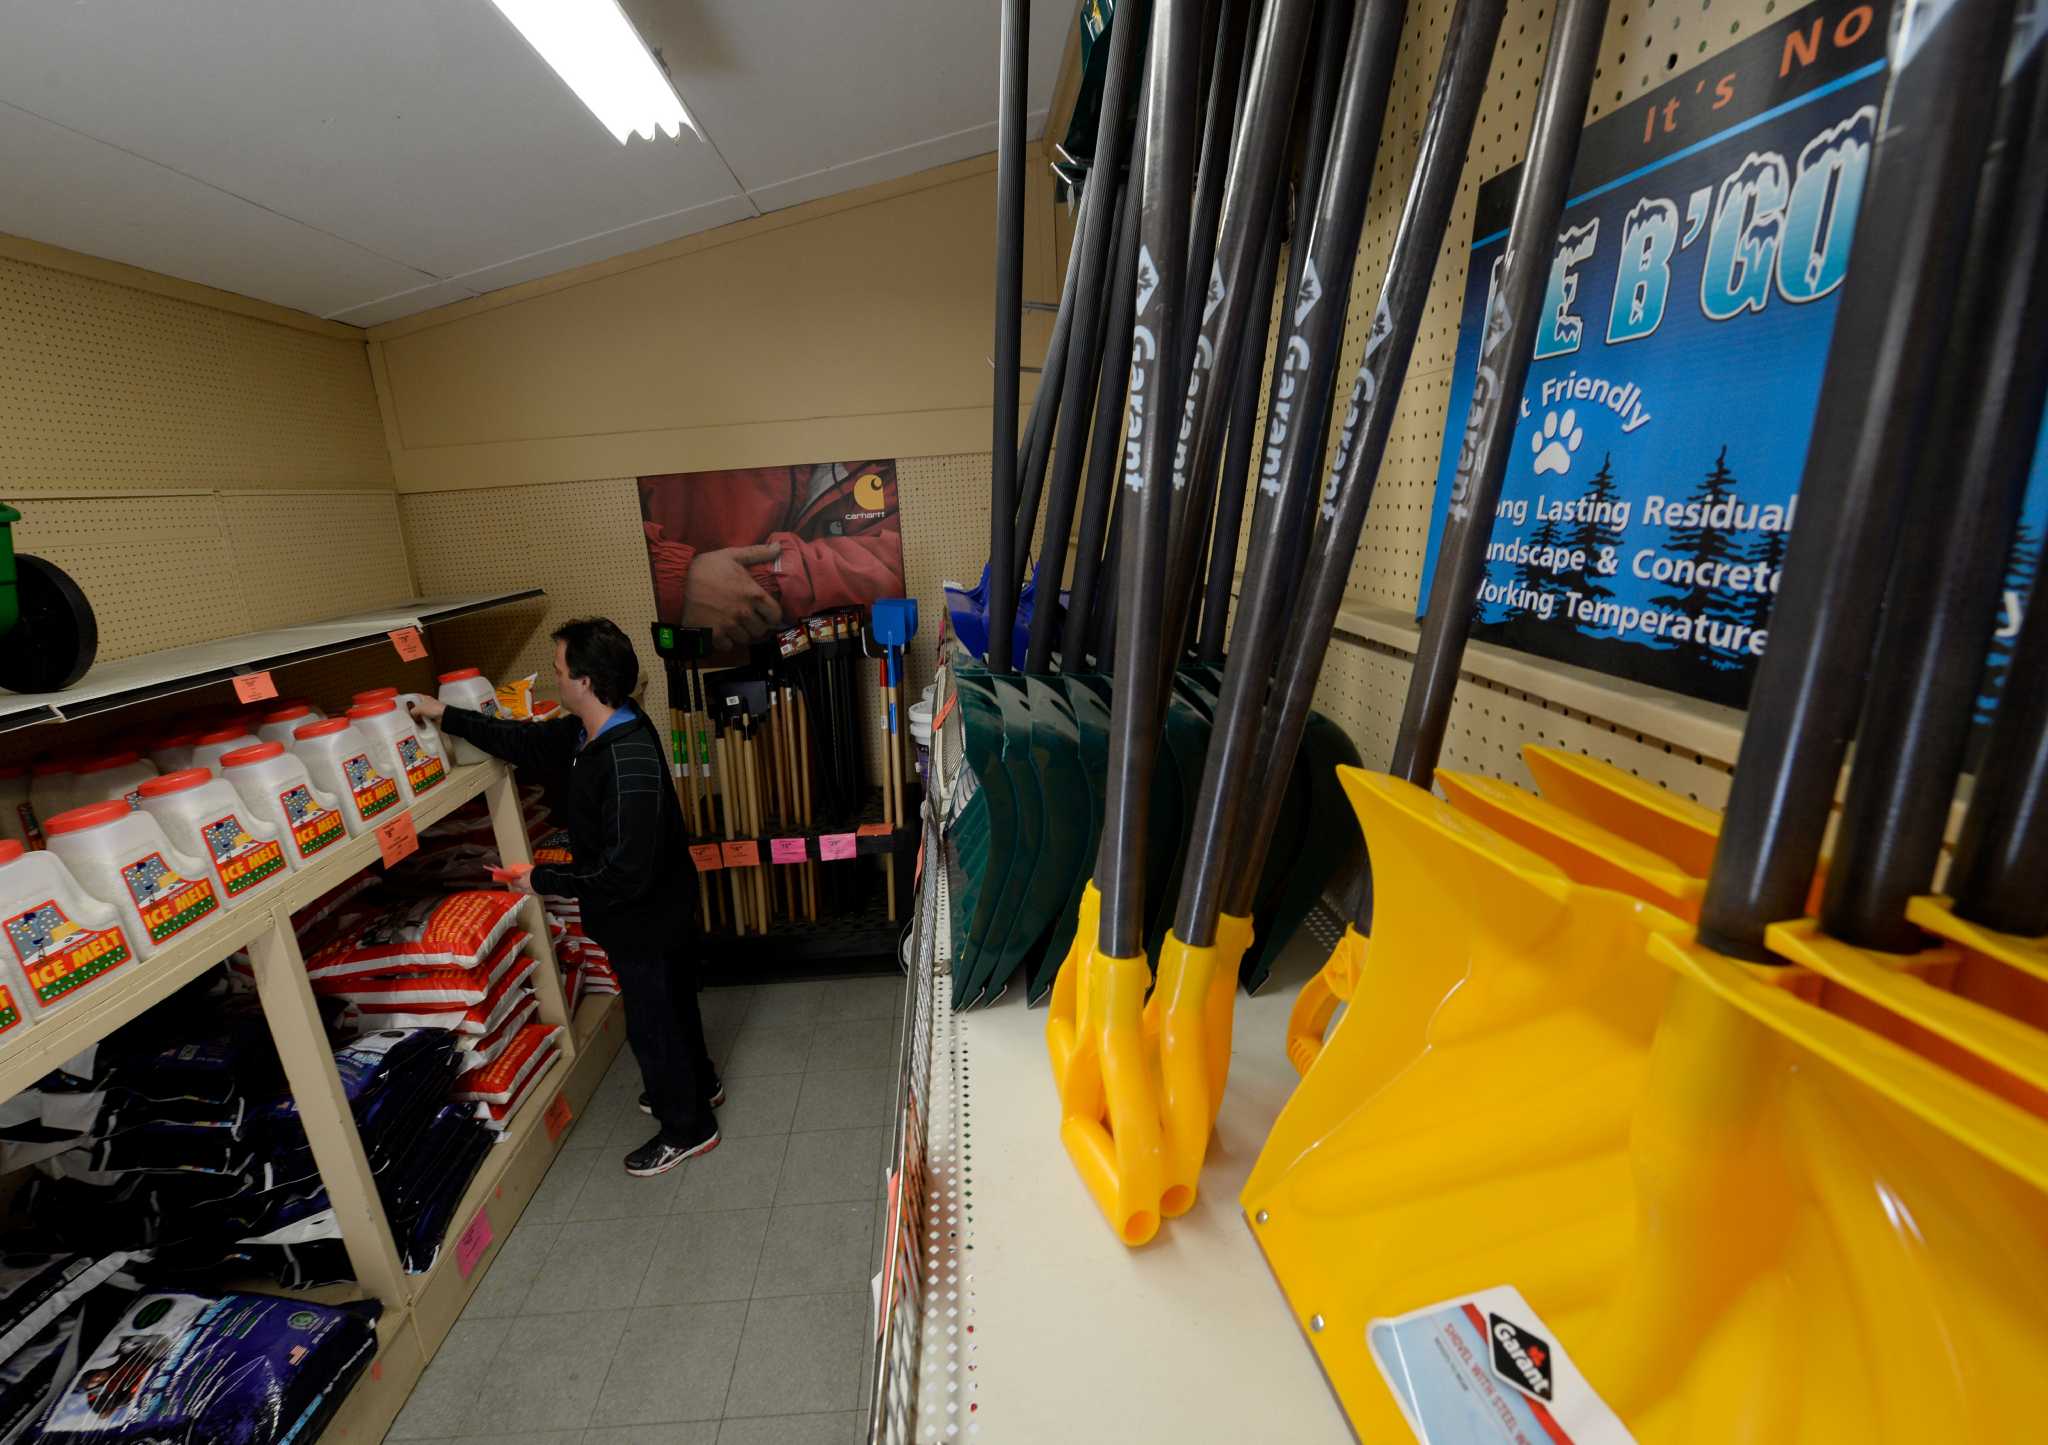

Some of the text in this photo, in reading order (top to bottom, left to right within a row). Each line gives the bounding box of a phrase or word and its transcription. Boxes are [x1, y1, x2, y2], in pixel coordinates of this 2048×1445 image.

[1643, 73, 1737, 144] It's
[1125, 325, 1156, 493] Garant
[1258, 335, 1310, 497] Garant
[1542, 371, 1651, 433] Friendly
[845, 511, 885, 520] carhartt
[1495, 493, 1798, 532] ng Lasting Residual
[1486, 537, 1586, 575] ndscape
[1596, 546, 1619, 575] &
[1566, 591, 1769, 656] Temperature
[356, 795, 375, 809] ICE
[375, 781, 395, 799] MELT
[409, 770, 425, 785] ICE
[425, 759, 442, 775] MELT
[295, 825, 316, 845] ICE
[316, 812, 341, 833] MELT
[221, 861, 246, 883] ICE
[247, 842, 281, 870] MELT
[143, 904, 173, 929] ICE
[174, 880, 212, 913] MELT
[29, 959, 68, 989] ICE
[72, 929, 121, 969] MELT
[1494, 1321, 1549, 1393] Garant
